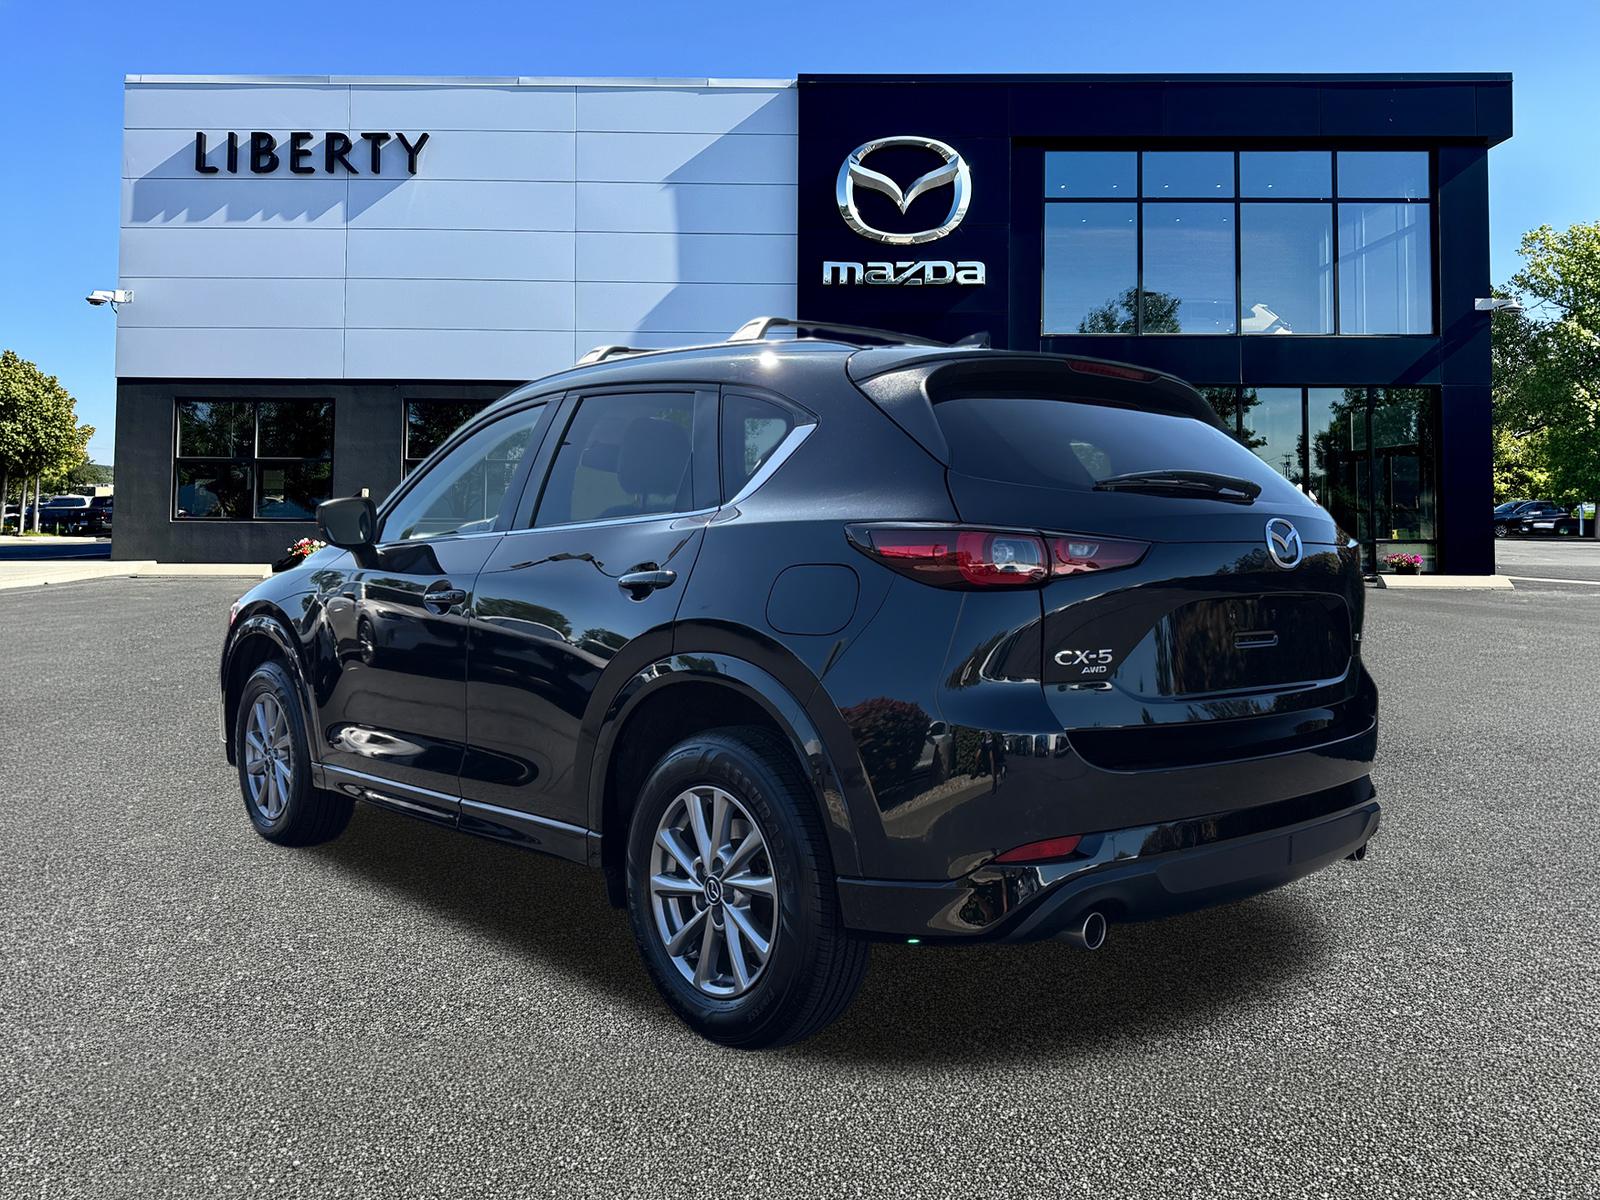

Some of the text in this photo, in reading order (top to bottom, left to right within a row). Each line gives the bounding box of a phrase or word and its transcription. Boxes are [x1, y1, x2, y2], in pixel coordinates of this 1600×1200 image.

[195, 131, 430, 175] LIBERTY
[1054, 649, 1113, 665] CX-5
[1081, 665, 1107, 674] AWD
